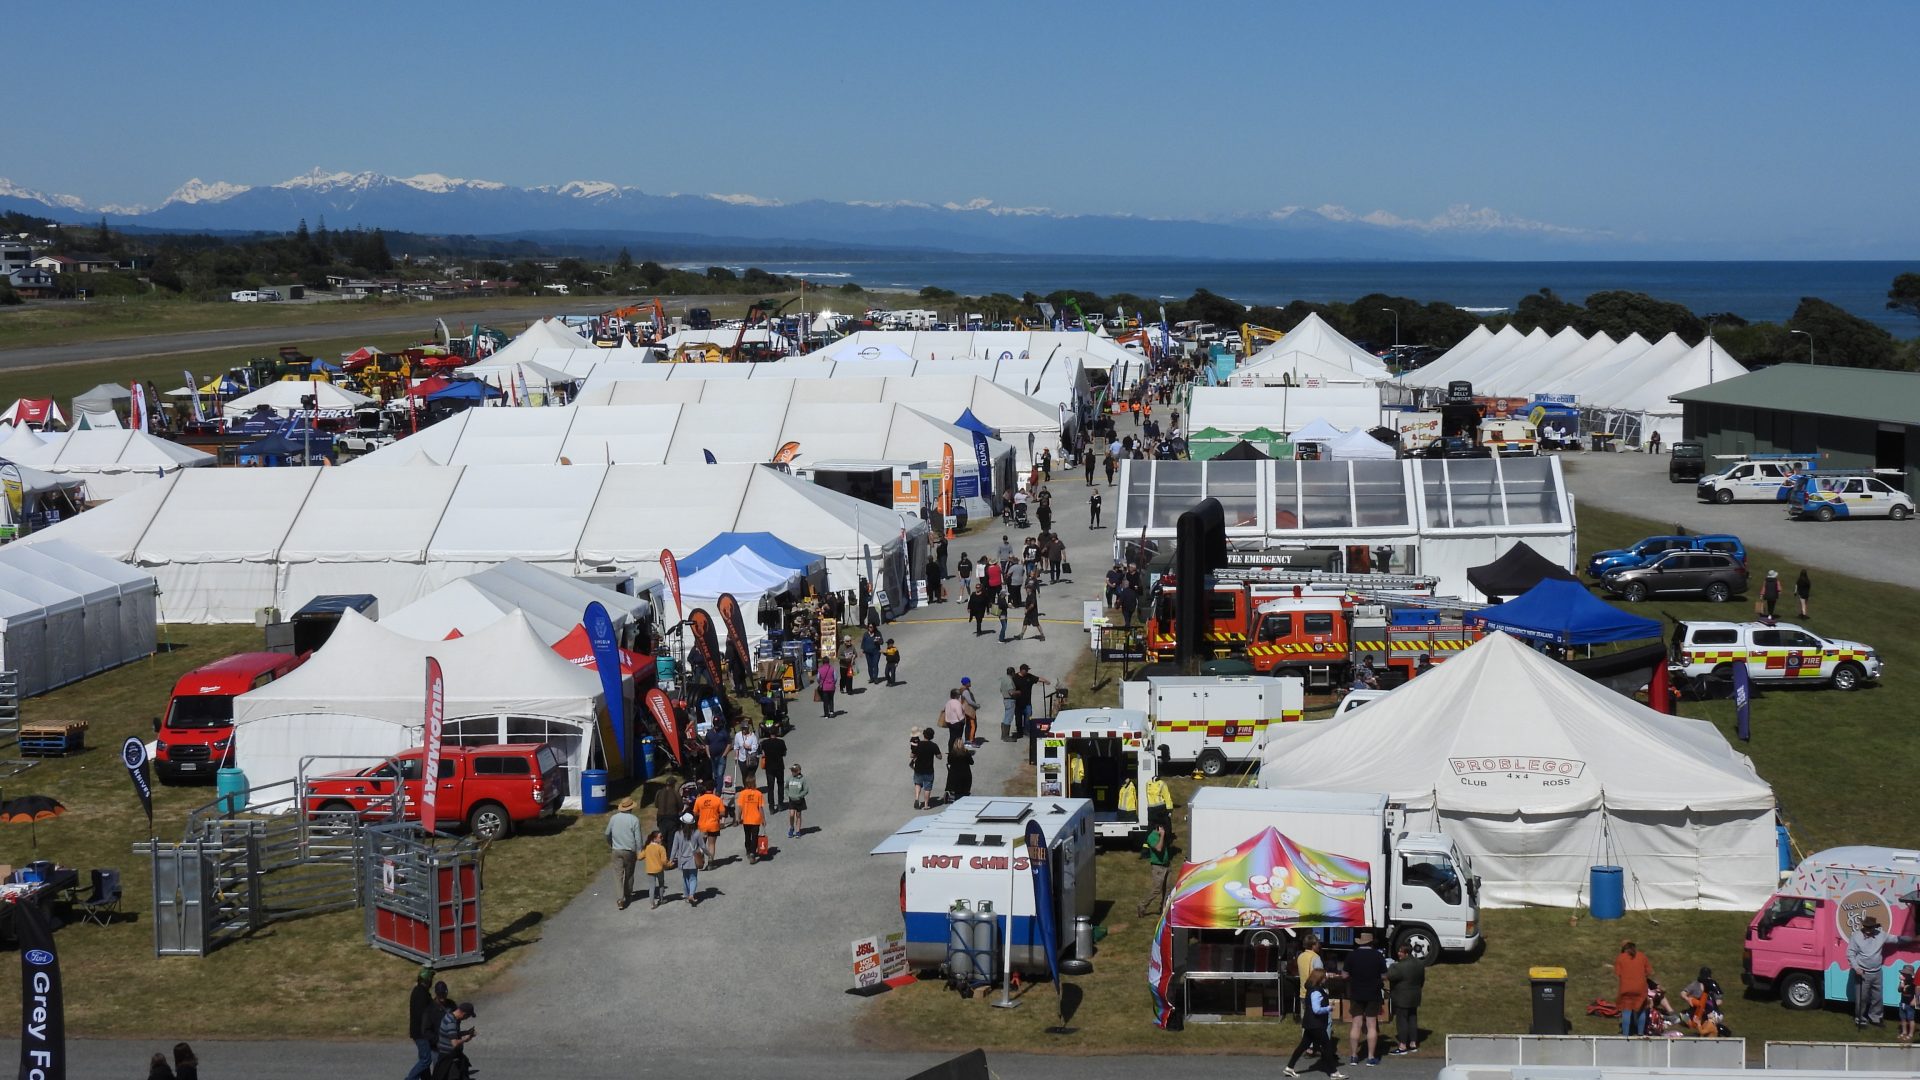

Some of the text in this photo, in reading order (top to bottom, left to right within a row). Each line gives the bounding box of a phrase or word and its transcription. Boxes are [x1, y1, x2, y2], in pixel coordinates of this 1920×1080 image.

[944, 455, 953, 480] levno
[1227, 554, 1292, 564] FEE EMERGENCY
[652, 694, 673, 733] Milwaukee
[1453, 758, 1573, 774] PROBLEGO
[1460, 777, 1487, 787] CLUB
[1543, 778, 1571, 787] ROSS
[922, 855, 963, 869] HOT
[28, 971, 50, 1041] Grey
